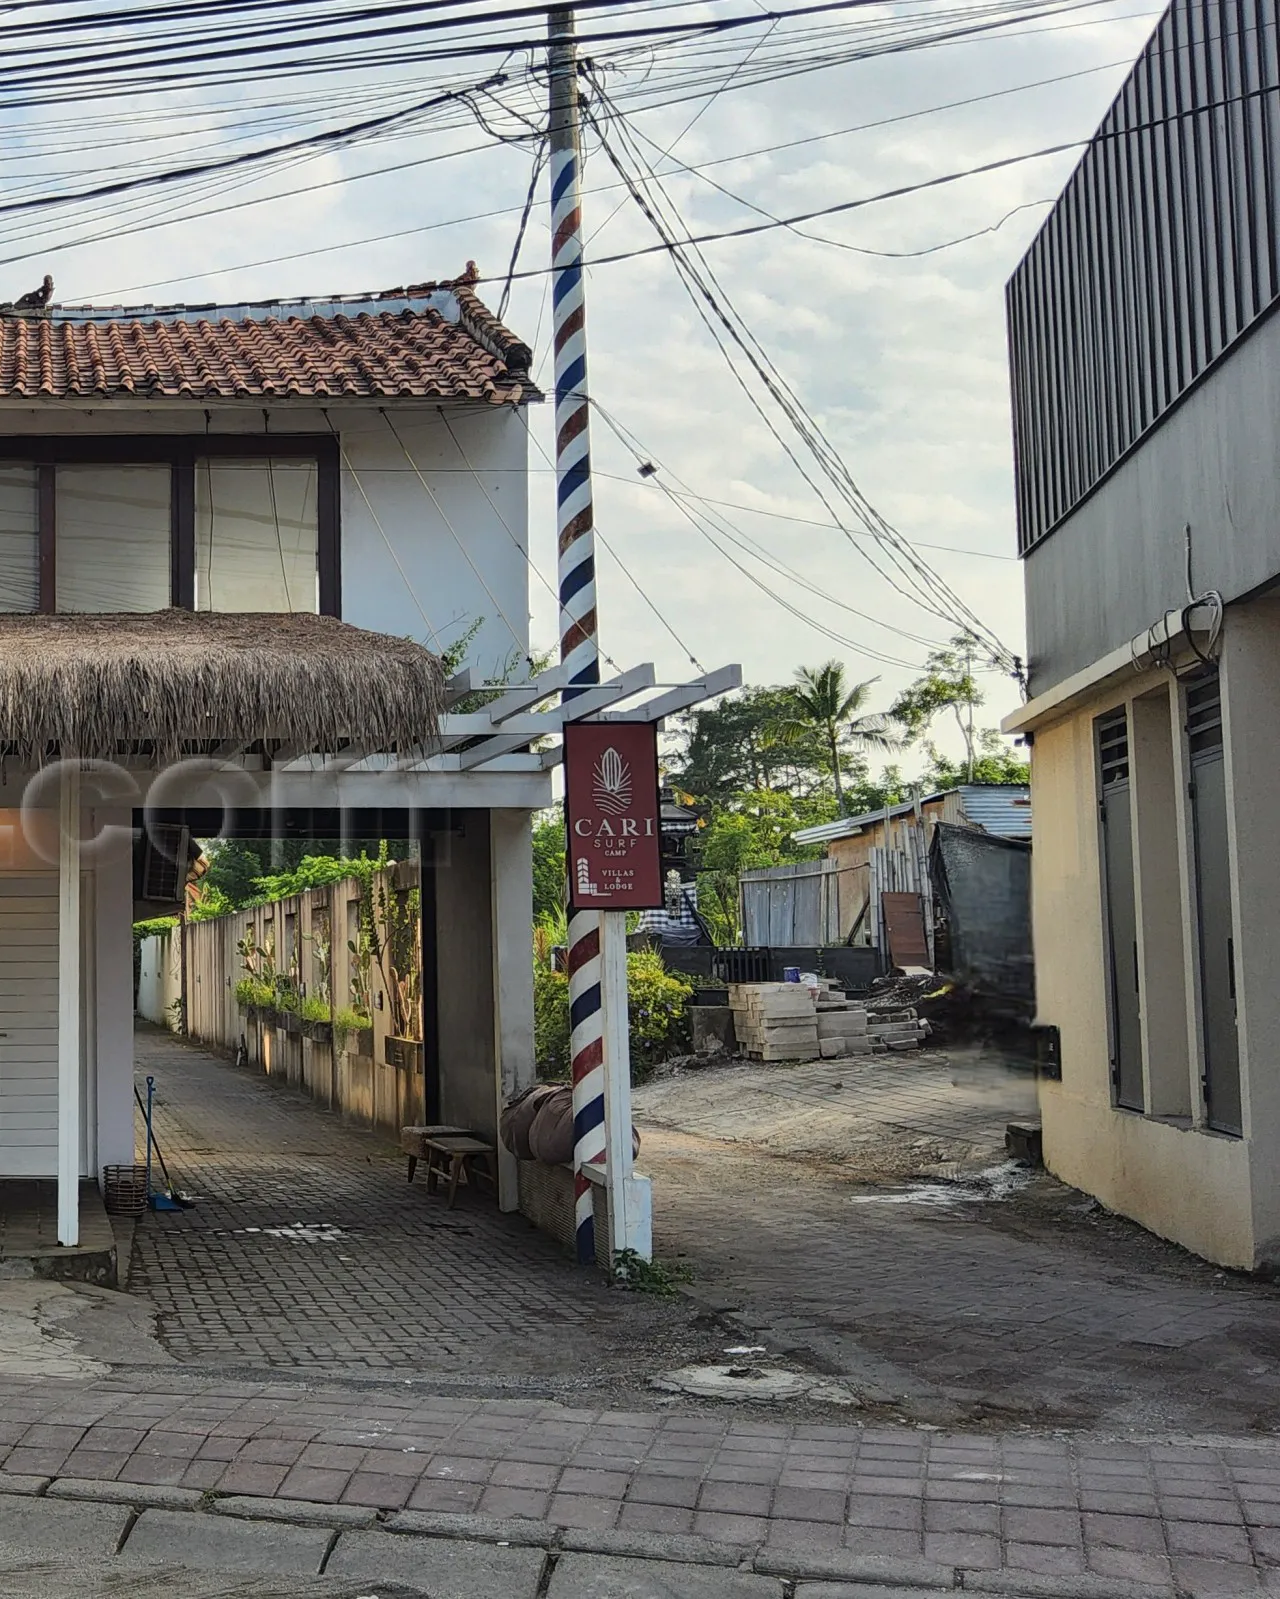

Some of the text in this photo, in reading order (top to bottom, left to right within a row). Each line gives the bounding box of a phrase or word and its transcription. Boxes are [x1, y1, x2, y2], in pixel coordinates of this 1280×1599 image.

[575, 818, 654, 837] CARI
[593, 838, 638, 848] SURF
[602, 869, 634, 877] VILLAS
